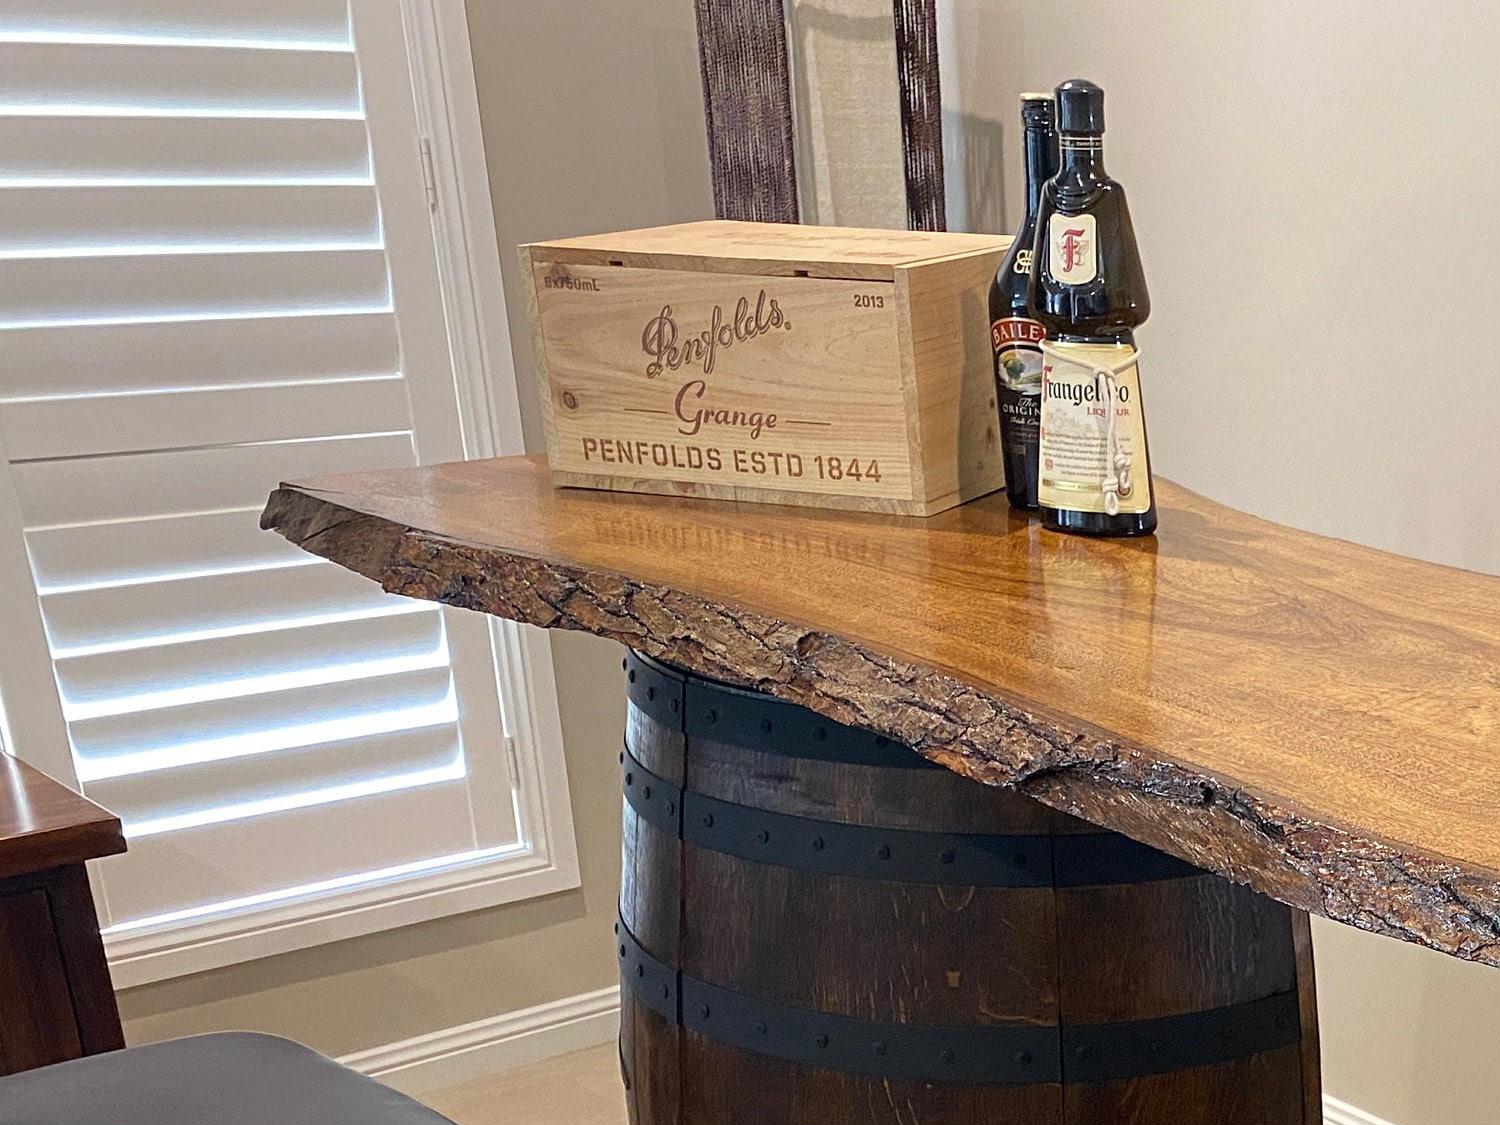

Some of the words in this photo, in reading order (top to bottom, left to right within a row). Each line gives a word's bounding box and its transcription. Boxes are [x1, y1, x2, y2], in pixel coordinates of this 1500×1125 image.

[854, 294, 885, 308] 2013
[1043, 365, 1129, 406] Frangelo
[674, 380, 777, 440] Grange
[582, 437, 722, 471] PENFOLDS
[733, 449, 803, 478] ESTD
[814, 454, 882, 483] 1844
